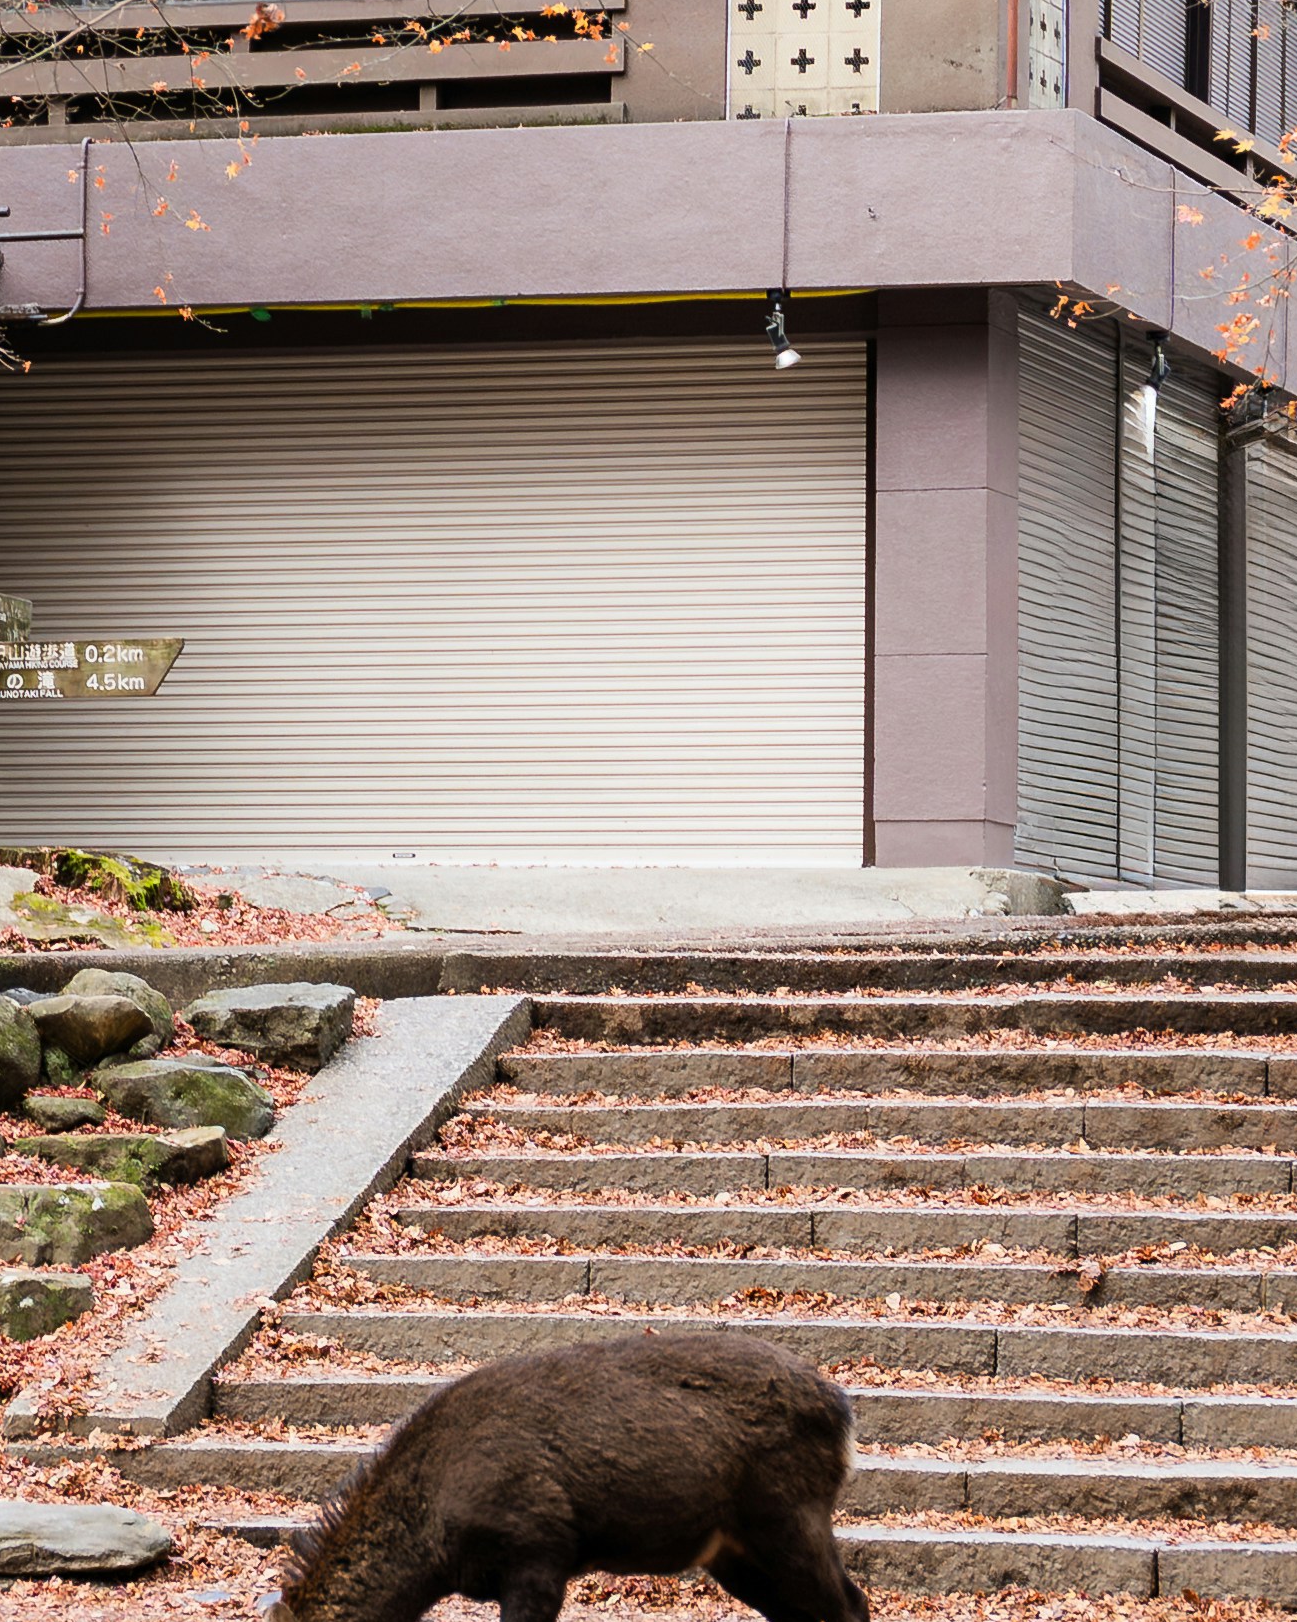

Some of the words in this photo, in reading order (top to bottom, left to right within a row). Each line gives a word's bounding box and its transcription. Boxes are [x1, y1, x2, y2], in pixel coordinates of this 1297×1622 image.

[85, 644, 143, 663] 0.2km
[25, 660, 48, 670] HIKING
[49, 659, 79, 669] COURSE
[86, 673, 145, 691] 4.5km
[40, 689, 64, 698] FALL
